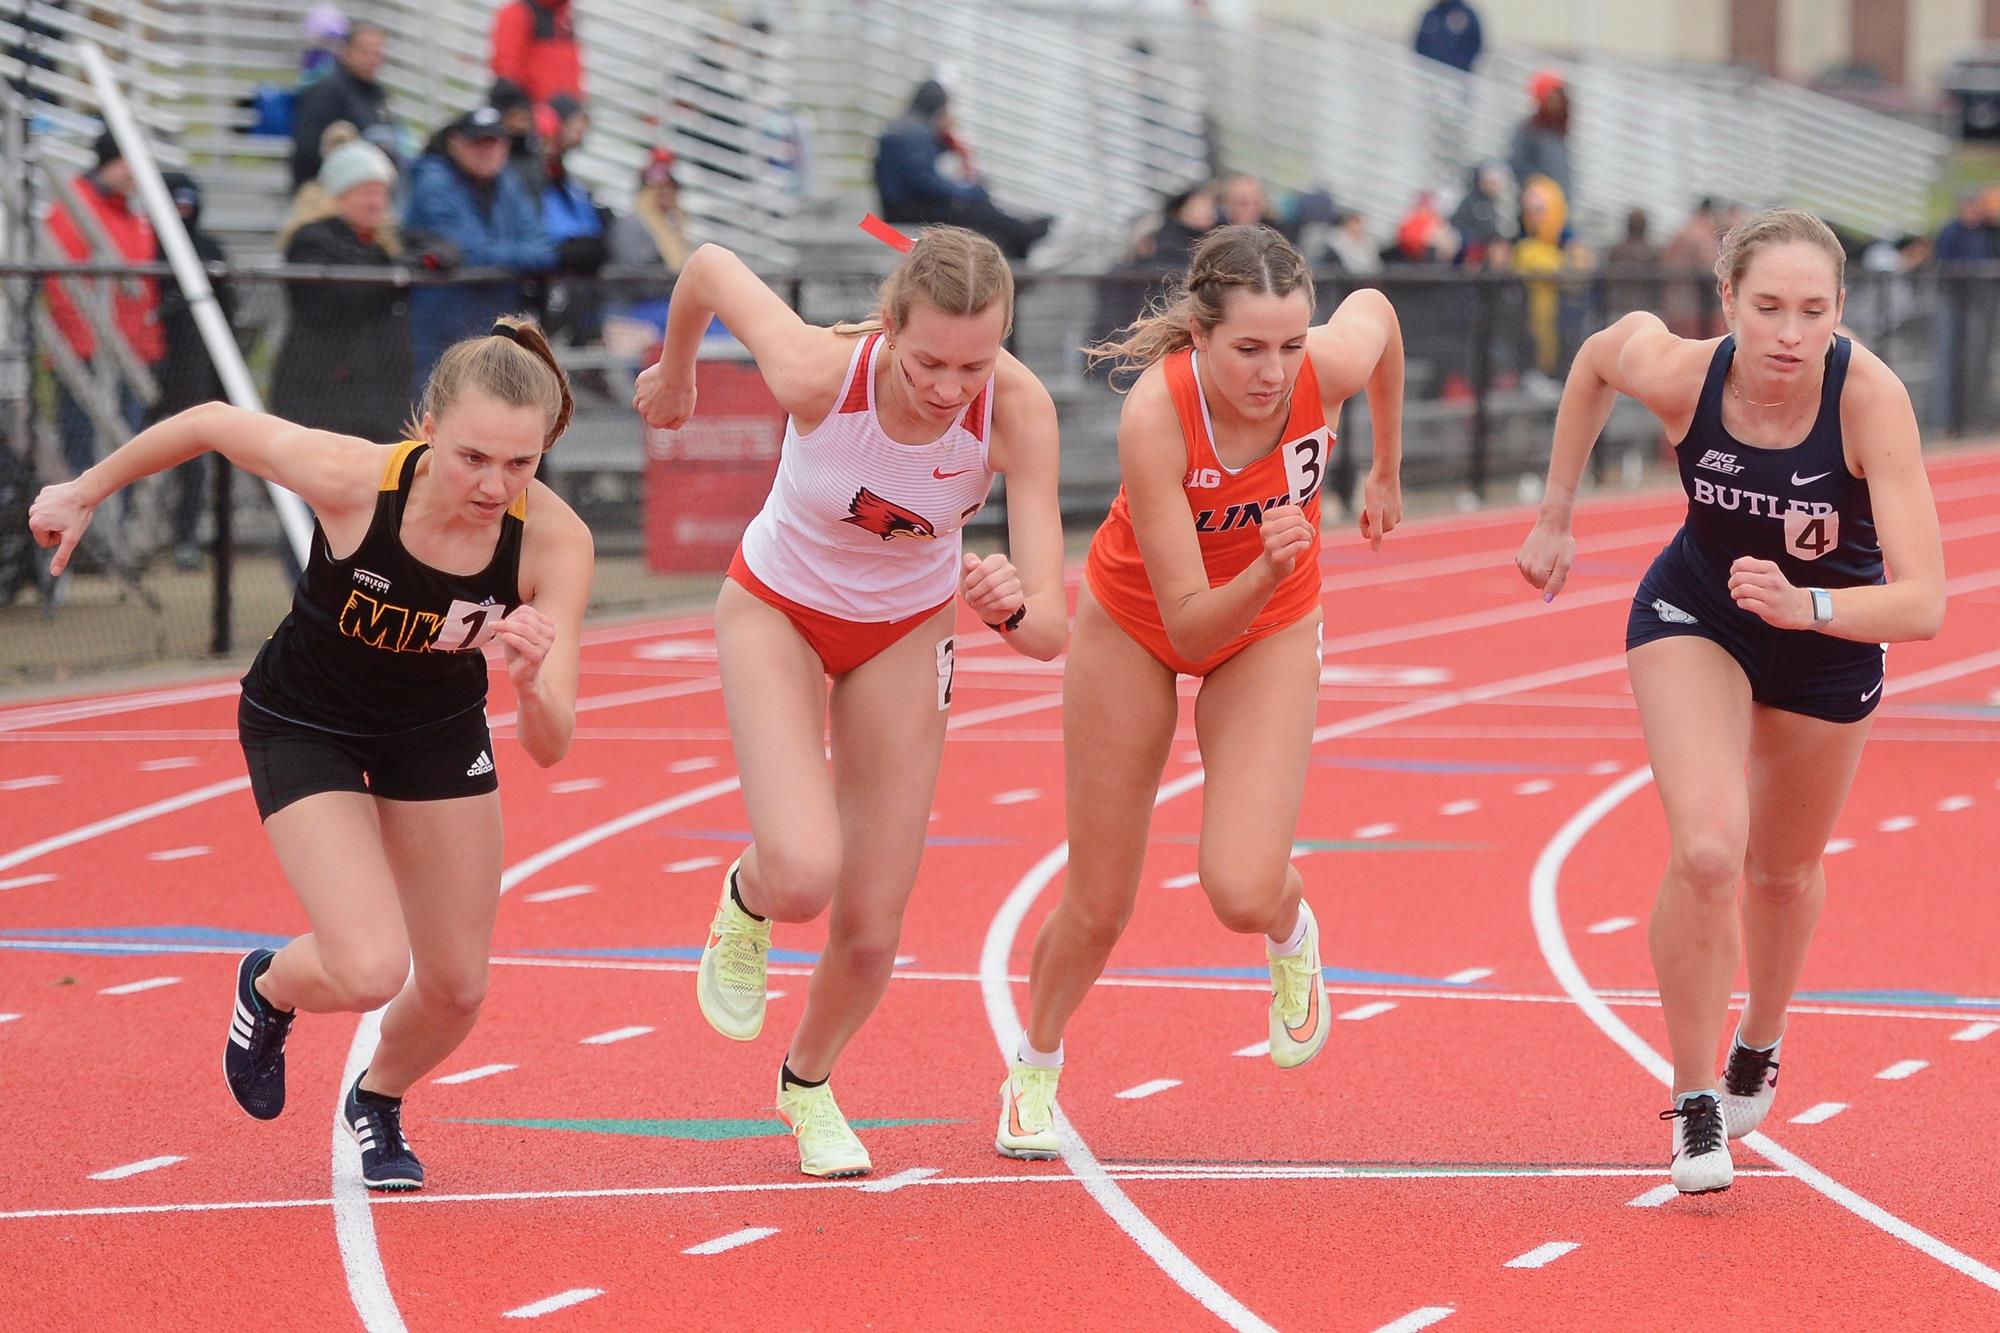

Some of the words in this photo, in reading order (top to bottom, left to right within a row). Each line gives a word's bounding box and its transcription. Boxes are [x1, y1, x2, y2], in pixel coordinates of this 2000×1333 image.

[1295, 438, 1320, 498] 3
[1699, 456, 1745, 474] EAST
[1704, 448, 1737, 464] BIG
[1795, 518, 1830, 557] 4
[353, 571, 390, 591] HORIZON
[339, 589, 470, 654] MK
[457, 609, 488, 649] 1
[466, 761, 494, 778] adidas
